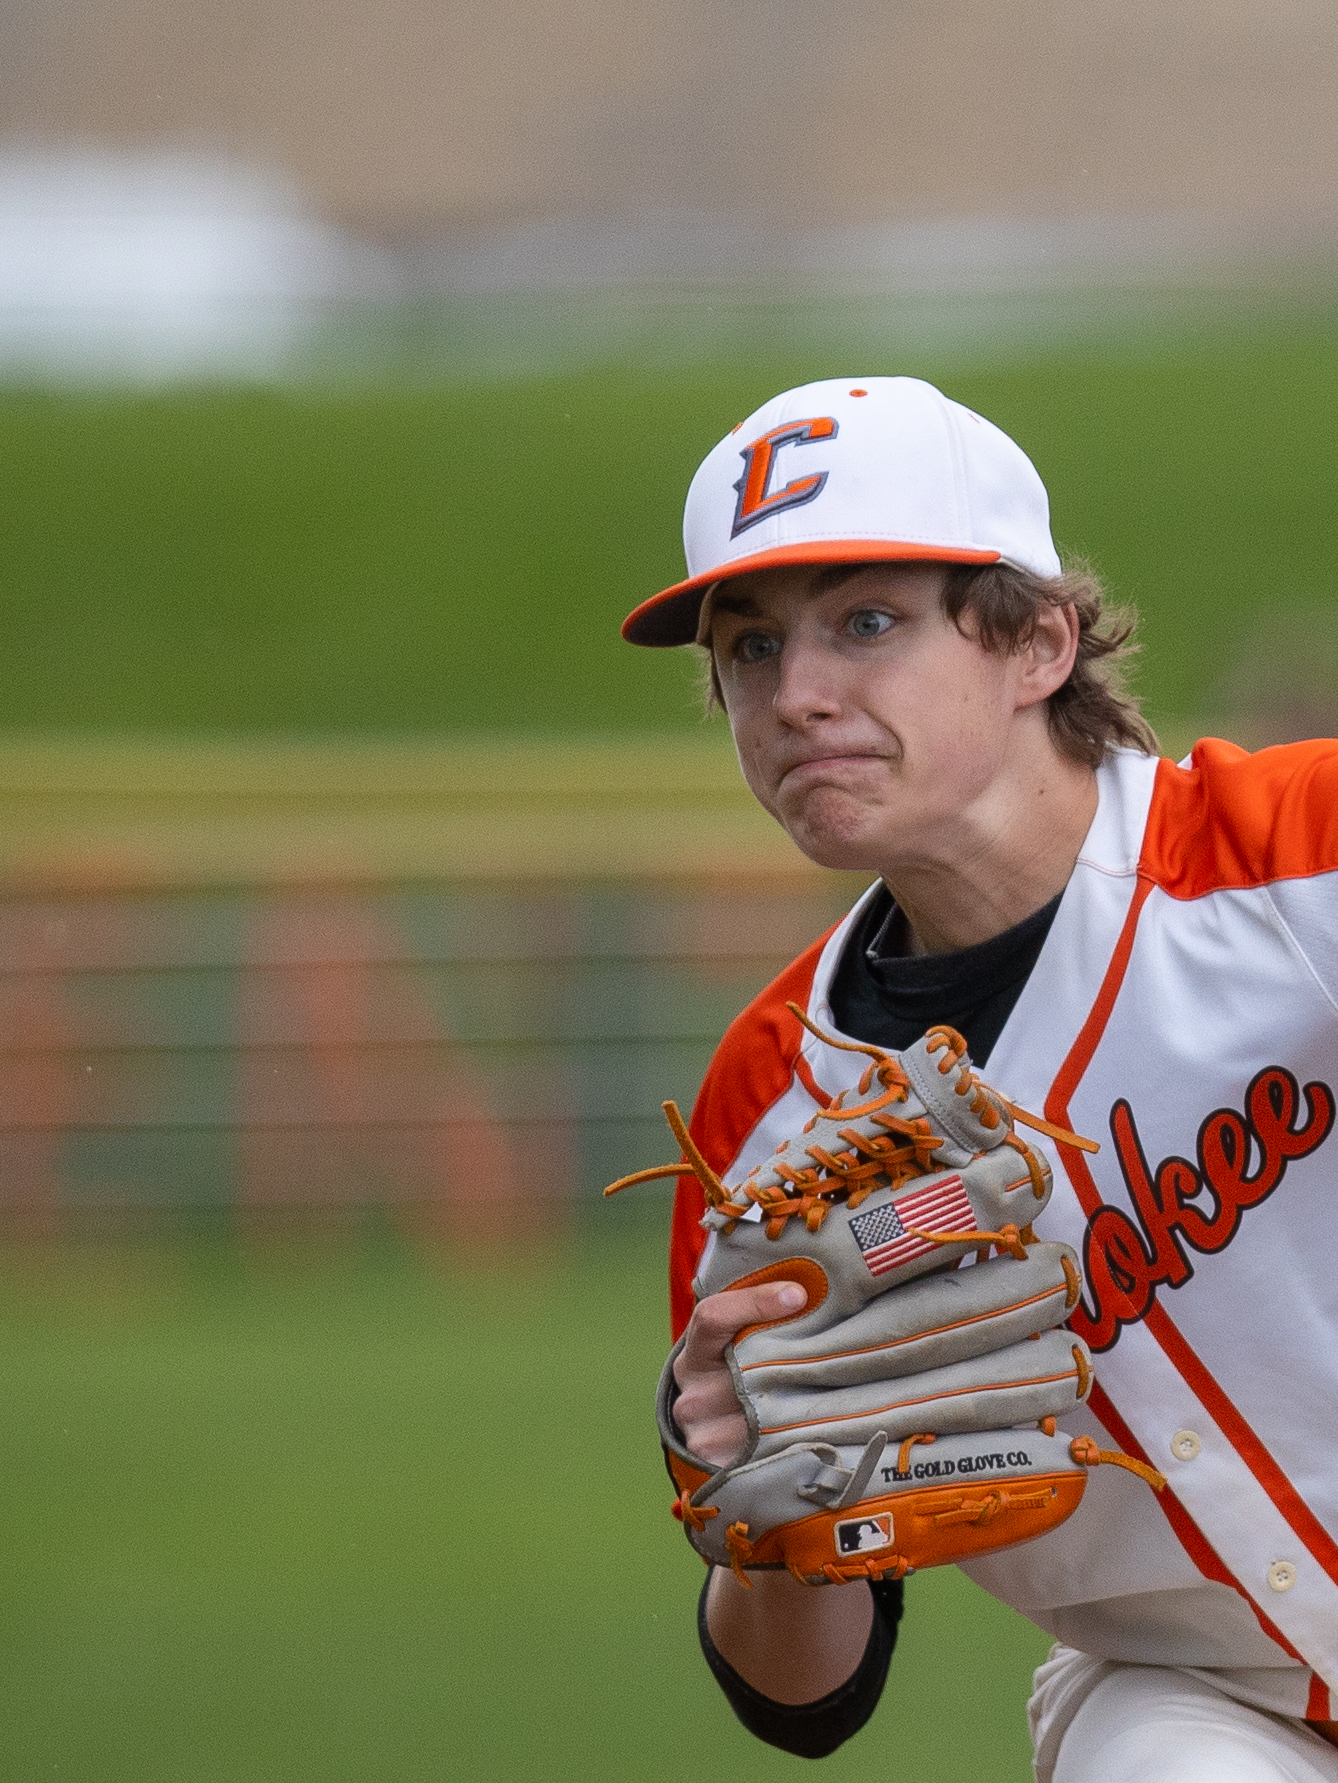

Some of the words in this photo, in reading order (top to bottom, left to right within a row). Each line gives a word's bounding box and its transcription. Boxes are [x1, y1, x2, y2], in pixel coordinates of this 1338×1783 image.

[730, 416, 839, 541] C
[1064, 1064, 1337, 1354] okee
[914, 1460, 955, 1479] GOLD
[957, 1453, 1006, 1473] GLOVE
